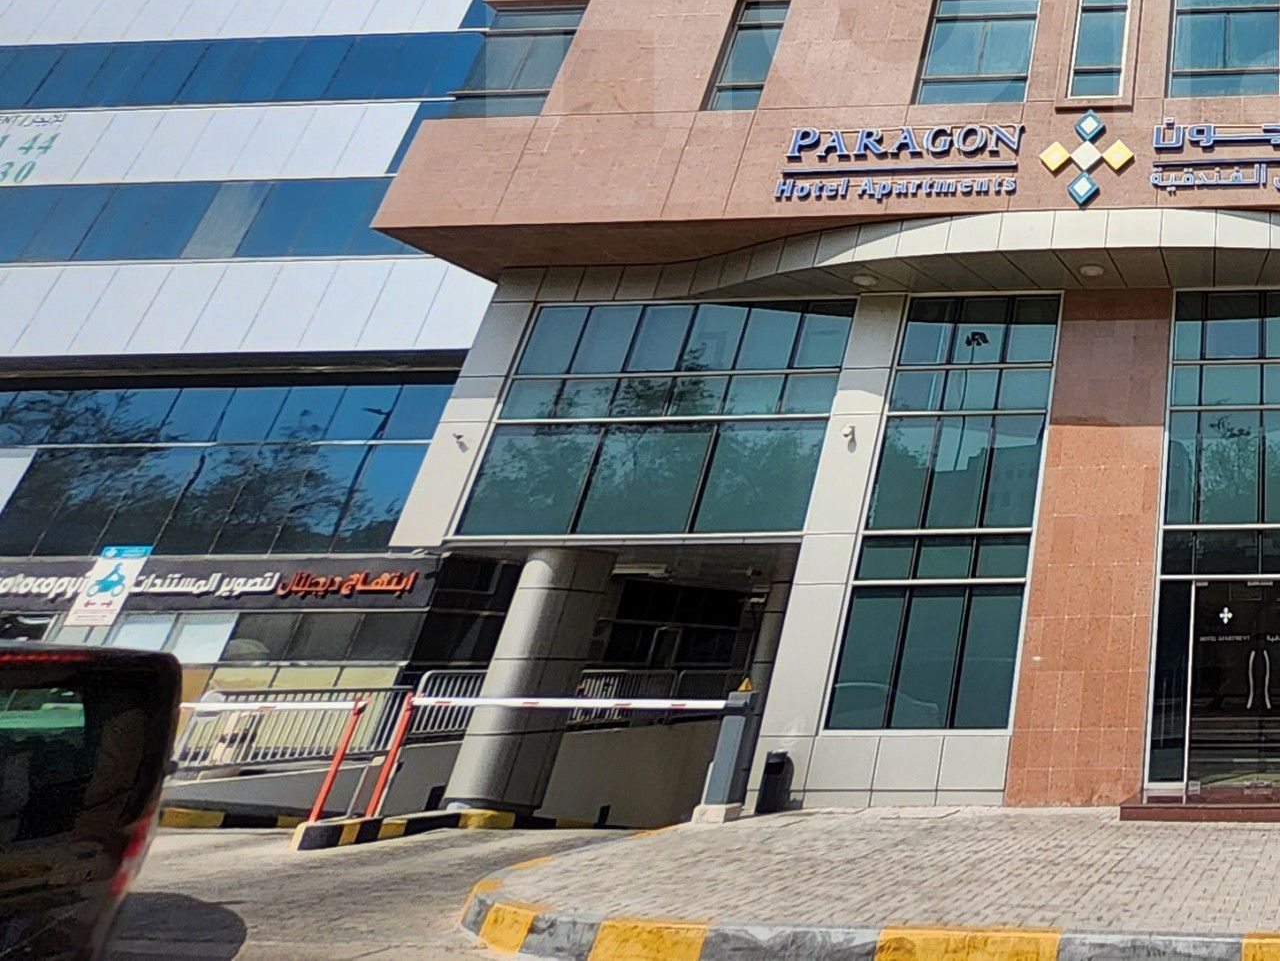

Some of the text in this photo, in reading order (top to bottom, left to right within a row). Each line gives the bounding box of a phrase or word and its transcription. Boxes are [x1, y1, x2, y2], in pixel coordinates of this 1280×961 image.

[786, 124, 1024, 159] PARAGON
[774, 174, 1017, 199] Hotel Apartments
[1150, 163, 1268, 193] الفندقية
[0, 572, 92, 600] otocopyi
[128, 572, 222, 594] المستندات
[214, 571, 281, 596] لتصوير
